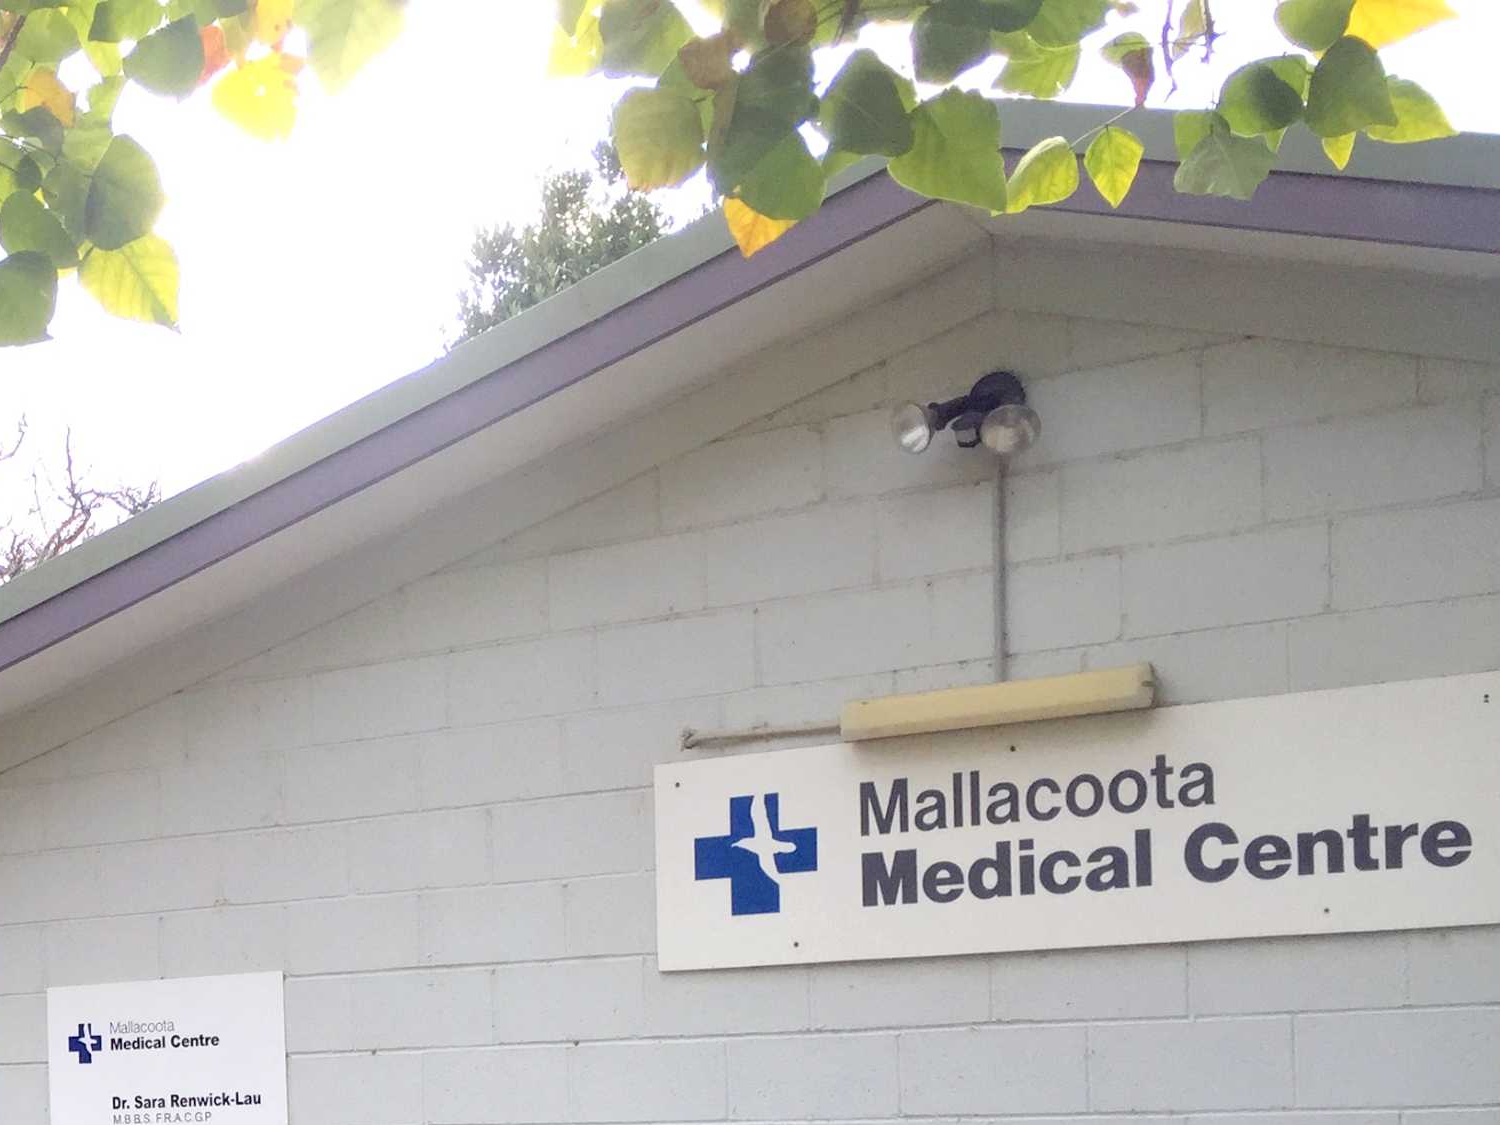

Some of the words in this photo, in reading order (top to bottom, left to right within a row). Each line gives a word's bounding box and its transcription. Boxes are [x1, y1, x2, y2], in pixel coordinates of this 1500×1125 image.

[859, 754, 1215, 836] Mallacoota
[861, 828, 1152, 907] Medical
[1184, 814, 1472, 883] Centre
[109, 1020, 175, 1034] Mallacoota
[110, 1036, 165, 1050] Medical
[171, 1034, 219, 1048] Centre
[112, 1096, 130, 1109] Dr.
[135, 1095, 165, 1109] Sara
[171, 1091, 261, 1108] Renwick-Lau
